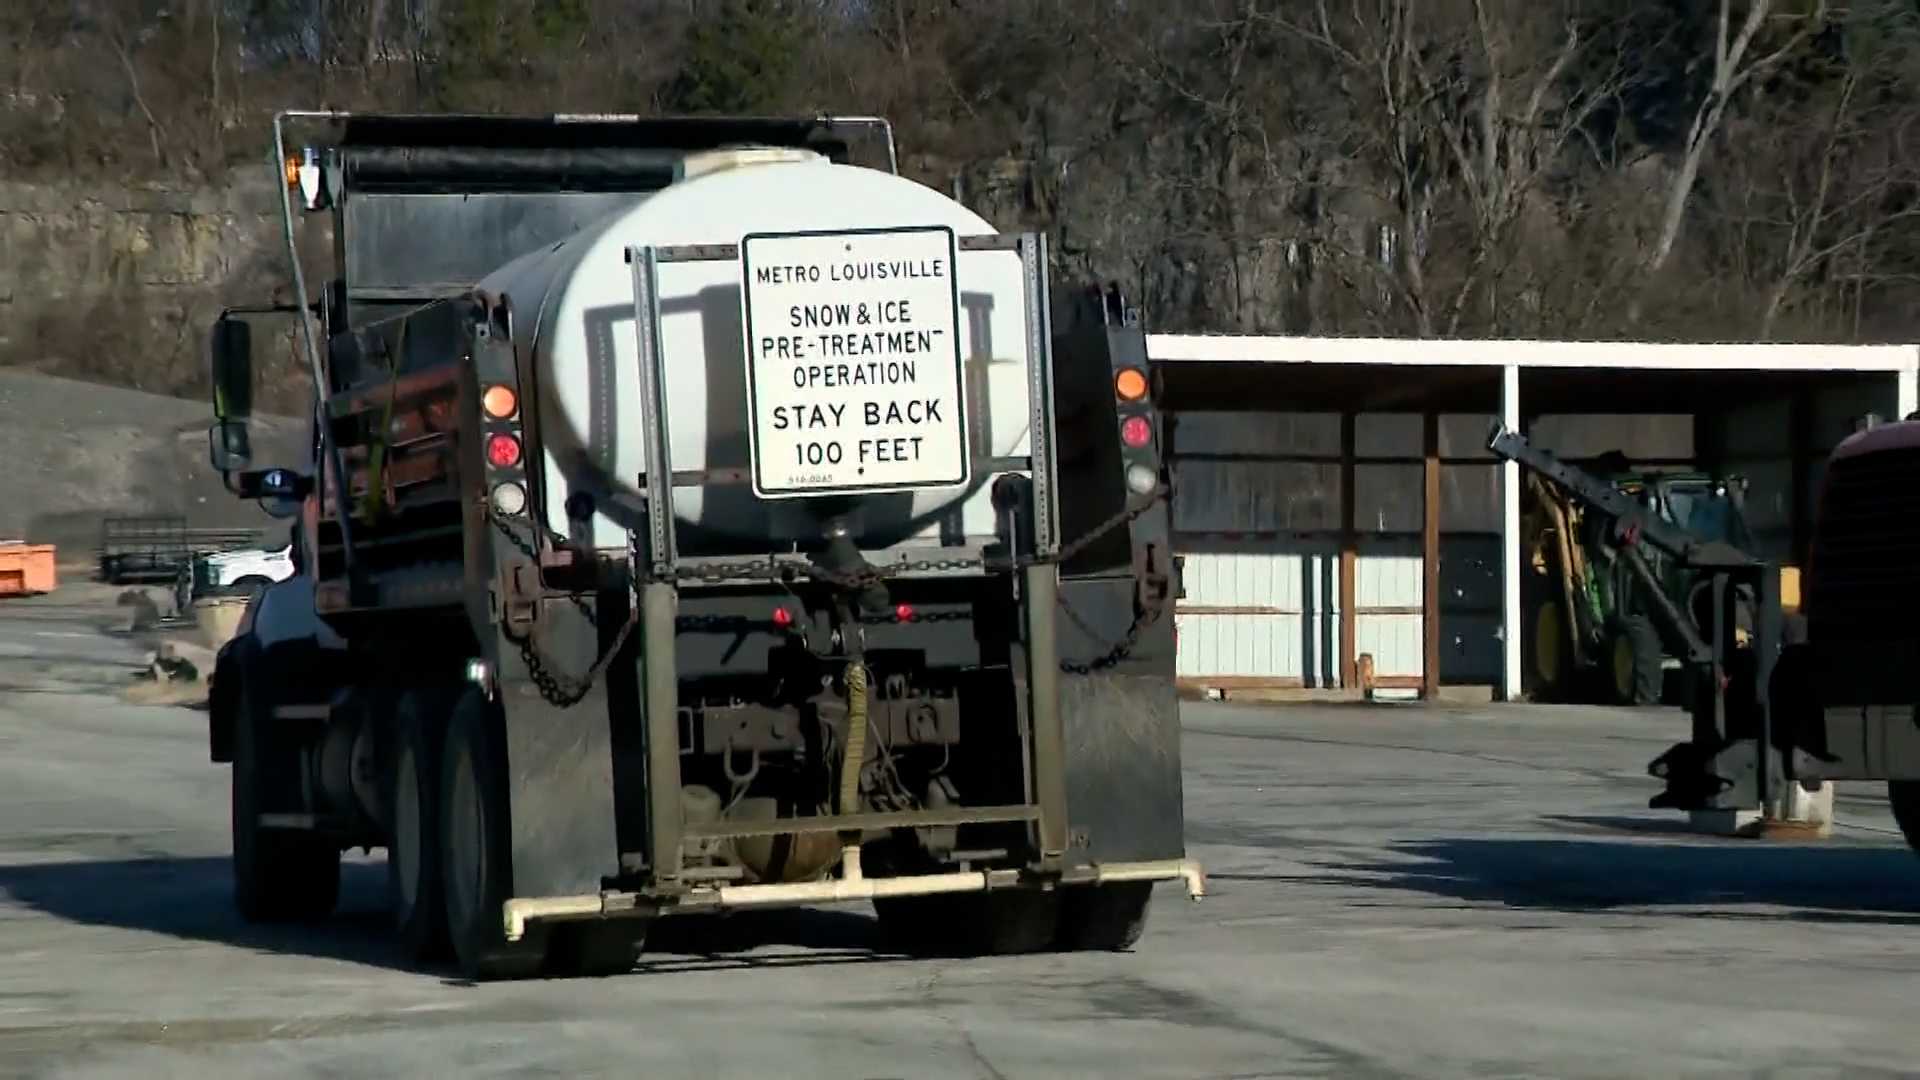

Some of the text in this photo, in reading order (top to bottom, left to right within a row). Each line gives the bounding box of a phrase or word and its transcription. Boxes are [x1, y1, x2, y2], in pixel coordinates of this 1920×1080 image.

[757, 260, 944, 284] METRO LOUISVILLE
[790, 300, 912, 328] SNOW & ICE
[793, 360, 916, 388] OPERATION
[773, 398, 943, 430] STAY BACK
[796, 437, 923, 465] 100 FEET
